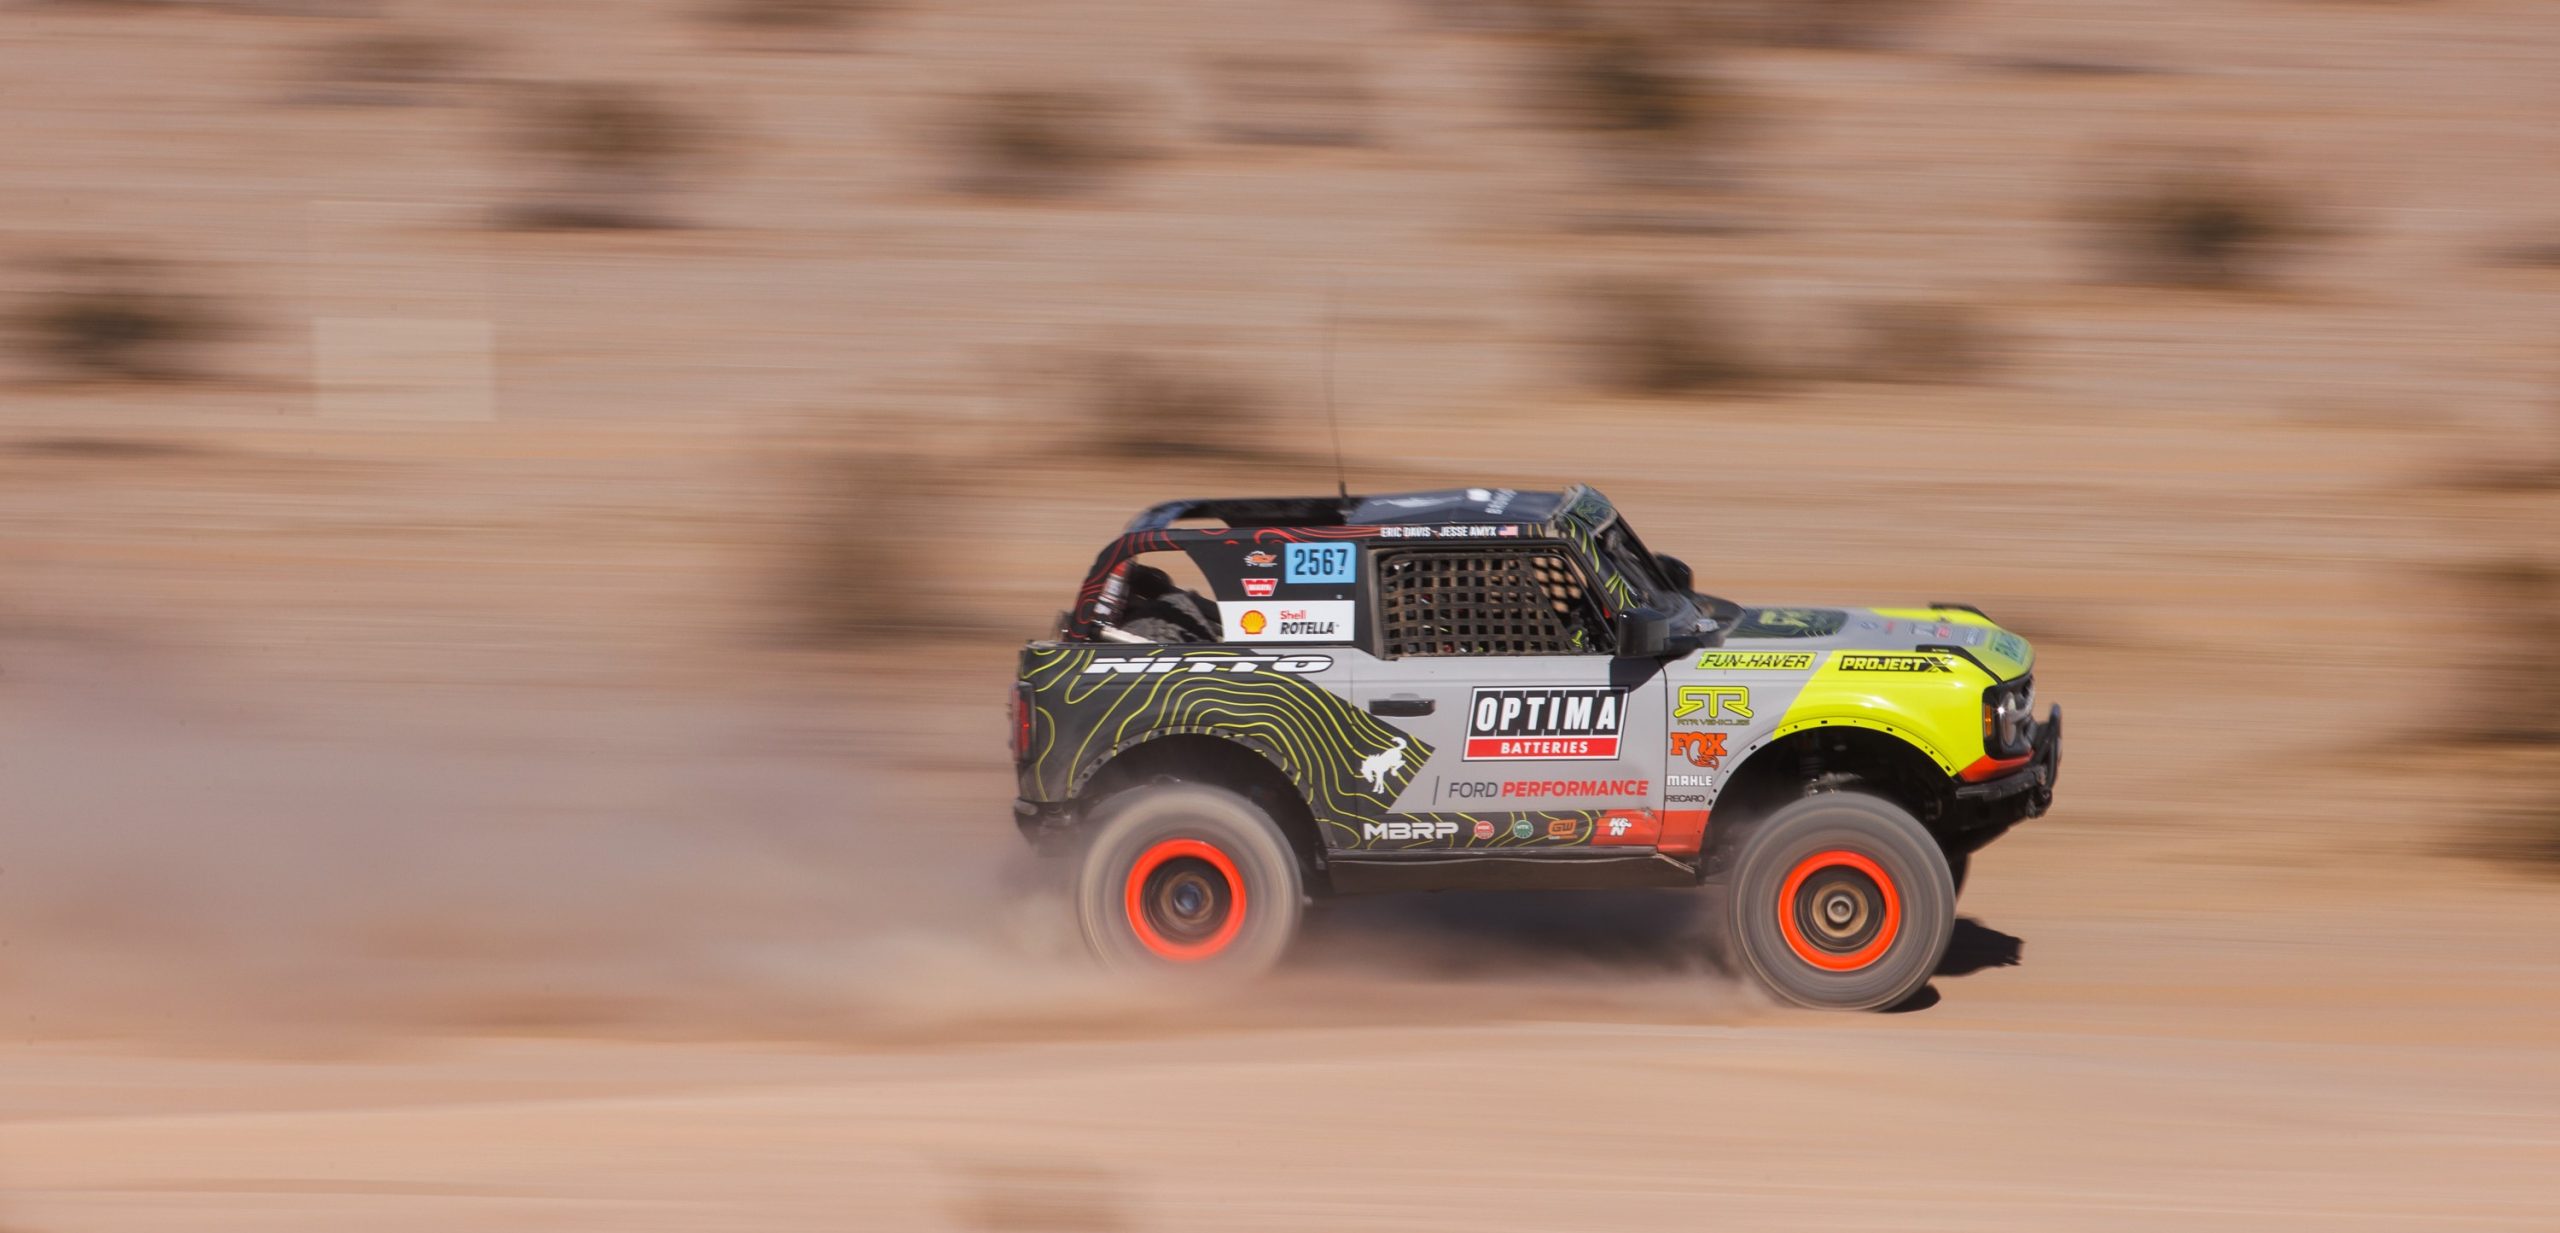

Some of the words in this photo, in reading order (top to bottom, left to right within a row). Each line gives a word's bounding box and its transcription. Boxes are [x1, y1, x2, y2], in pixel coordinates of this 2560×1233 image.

[1380, 526, 1402, 538] ERIC
[1403, 526, 1431, 538] DAVIS
[1439, 525, 1468, 537] JESSE
[1469, 525, 1497, 537] AMYX
[1294, 548, 1349, 576] 2567
[1280, 610, 1307, 620] Shell
[1280, 621, 1335, 635] ROTELLA
[1083, 654, 1334, 674] NITTO
[1702, 654, 1810, 668] FUN-HAVER
[1475, 696, 1616, 732] OPTIMA
[1500, 741, 1589, 755] BATTERIES
[1670, 731, 1728, 768] FOX
[1667, 775, 1713, 786] MAHLE
[1449, 782, 1498, 798] FORD
[1502, 779, 1649, 798] PERFORMANCE
[1665, 794, 1705, 803] RECARO
[1363, 822, 1459, 840] MBRP
